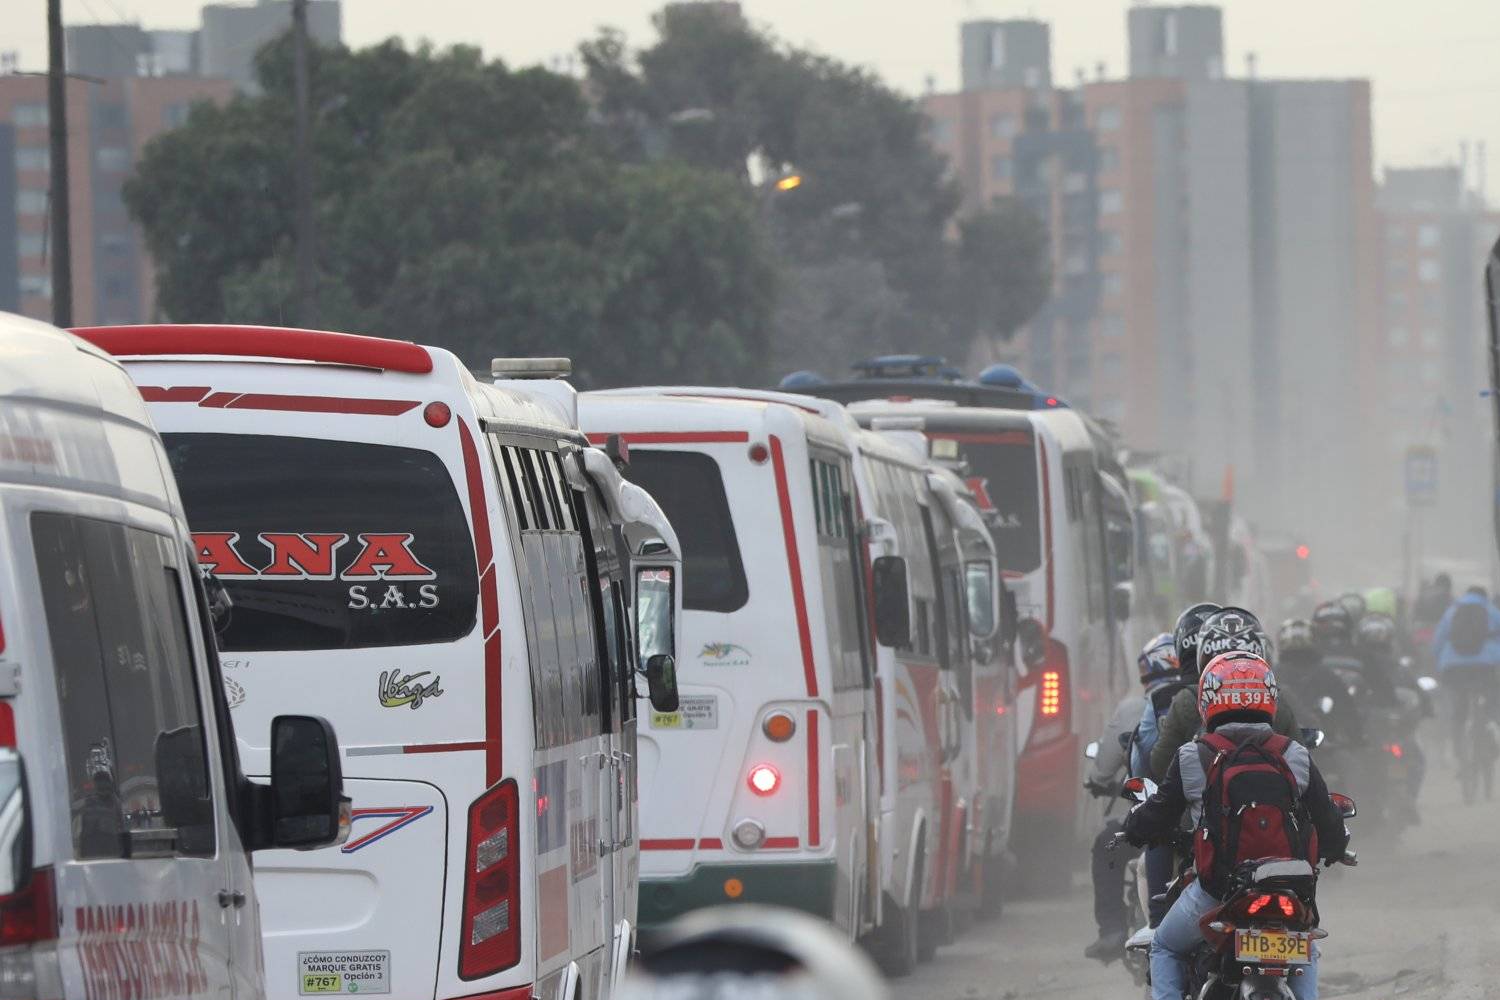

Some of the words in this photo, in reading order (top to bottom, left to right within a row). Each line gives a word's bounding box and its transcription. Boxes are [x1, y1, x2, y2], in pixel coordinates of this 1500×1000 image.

[1240, 934, 1270, 953] HTB
[1277, 937, 1307, 955] 39E
[335, 955, 386, 963] CONDUZCO?
[308, 964, 347, 973] MARQUE
[307, 977, 337, 986] #767
